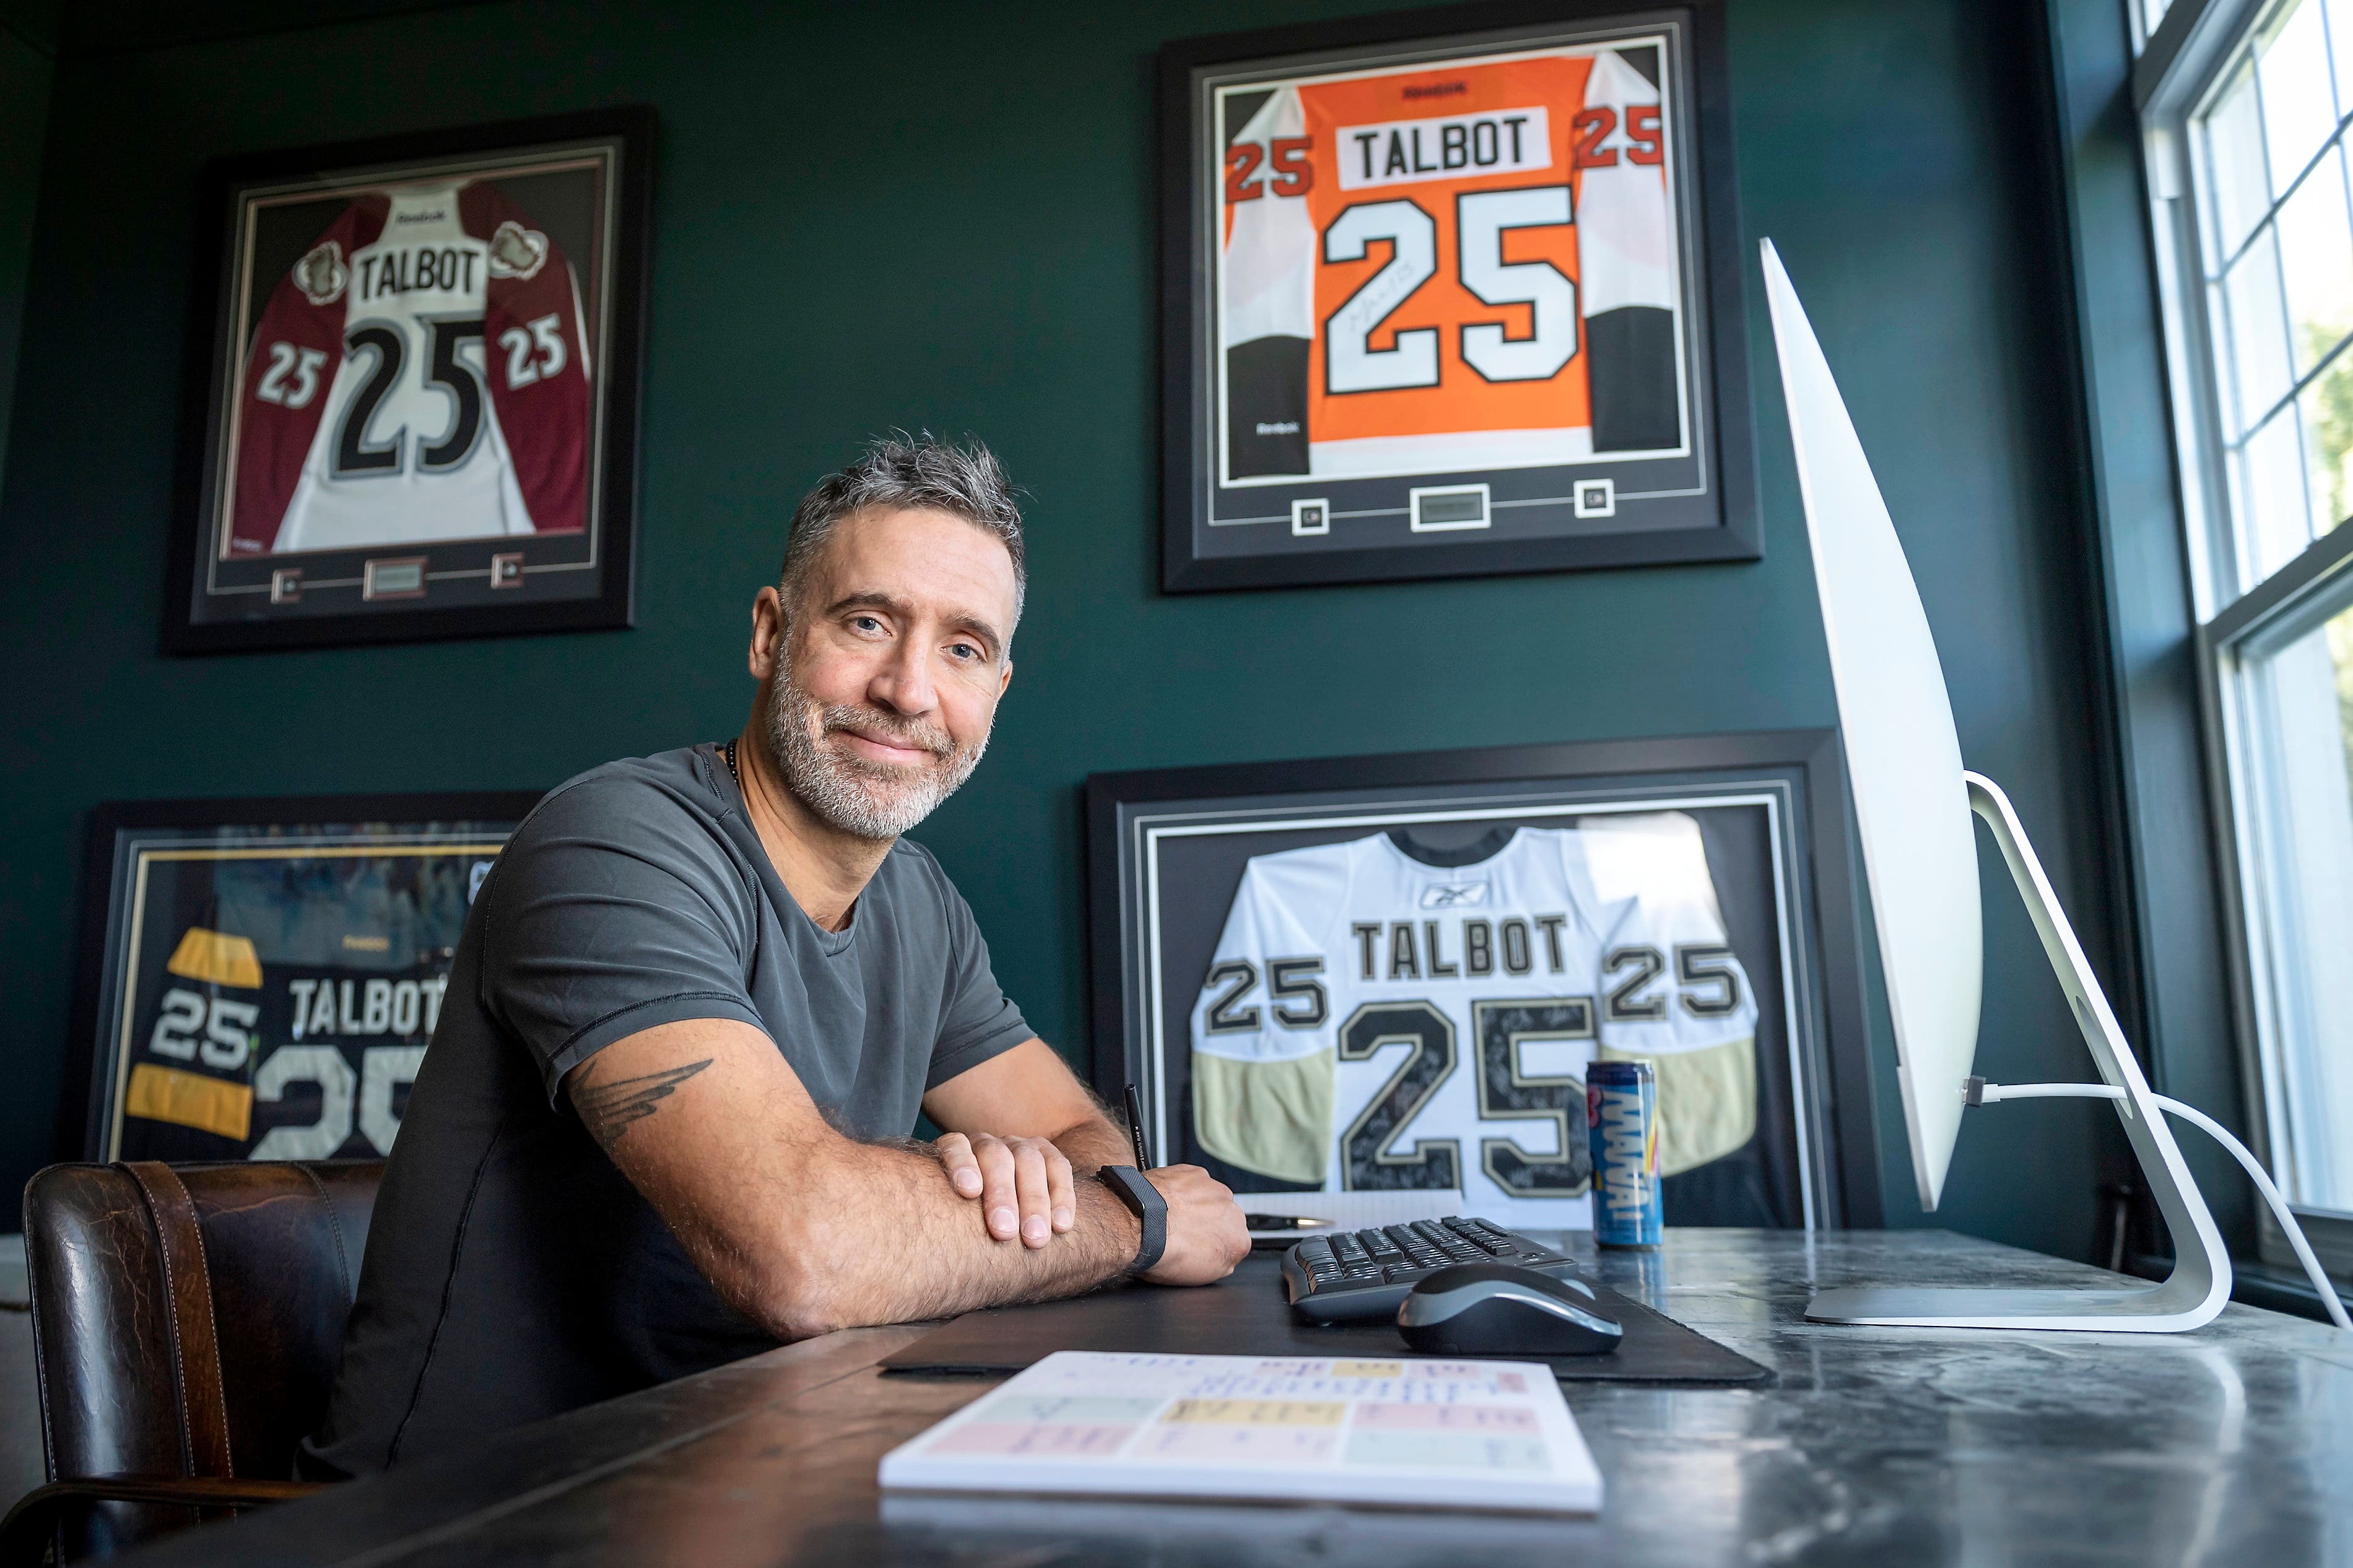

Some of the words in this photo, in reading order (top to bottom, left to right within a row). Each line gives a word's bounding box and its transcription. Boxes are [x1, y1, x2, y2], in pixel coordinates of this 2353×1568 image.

[1225, 136, 1313, 203] 25
[1355, 117, 1528, 180] TALBOT
[1573, 104, 1664, 169] 25
[359, 248, 480, 301] TALBOT
[1323, 184, 1578, 396] 25
[257, 341, 328, 409] 25
[498, 314, 568, 391] 25
[329, 311, 486, 481] 25
[1350, 914, 1570, 981] TALBOT
[1603, 942, 1741, 1021] 25
[149, 988, 260, 1071] 25
[289, 977, 449, 1039] TALBOT
[1204, 956, 1329, 1036] 25
[1337, 995, 1596, 1198] 25
